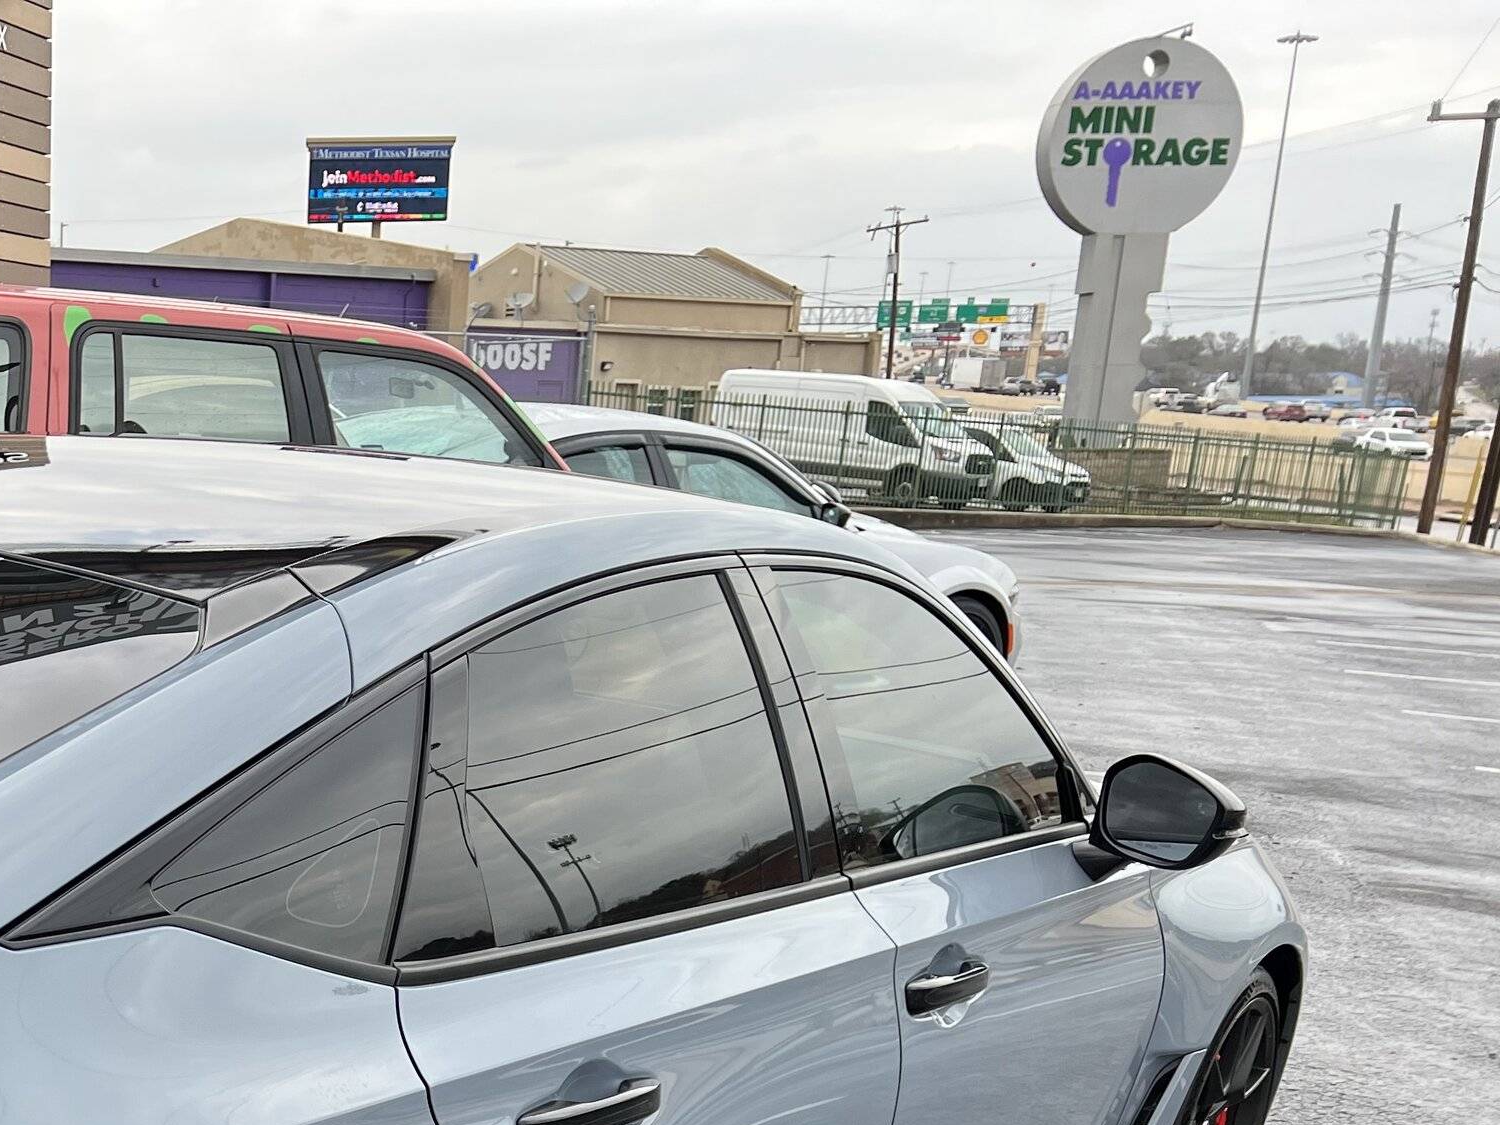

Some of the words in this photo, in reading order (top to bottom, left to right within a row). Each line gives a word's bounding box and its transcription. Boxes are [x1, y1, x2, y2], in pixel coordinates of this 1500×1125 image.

[1074, 81, 1202, 100] A-AAAKEY
[1068, 106, 1156, 134] MINI
[1061, 137, 1231, 167] STORAGE
